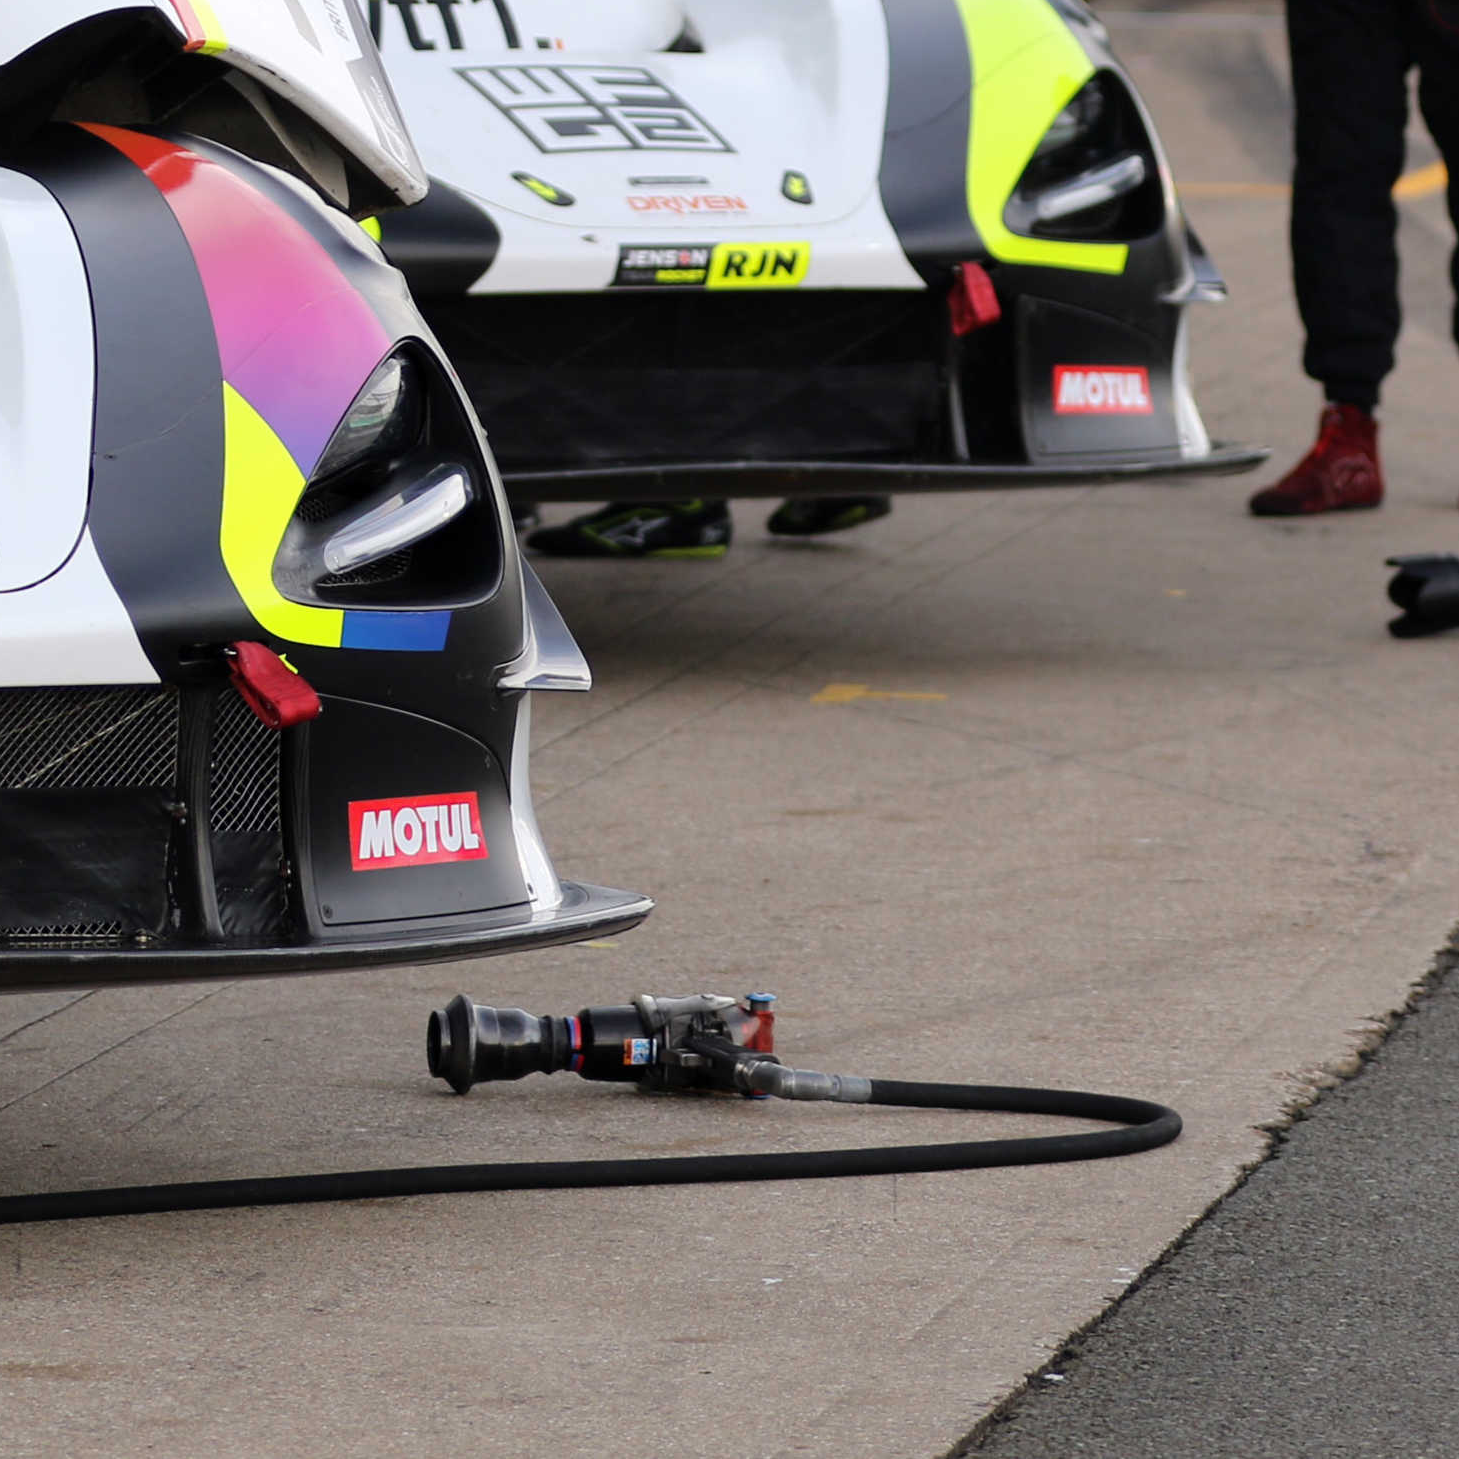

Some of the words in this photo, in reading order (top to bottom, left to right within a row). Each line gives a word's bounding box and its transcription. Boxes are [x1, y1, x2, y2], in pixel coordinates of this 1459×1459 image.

[722, 250, 799, 278] RJN
[1057, 371, 1147, 408] MOTUL
[358, 802, 481, 860] MOTUL
